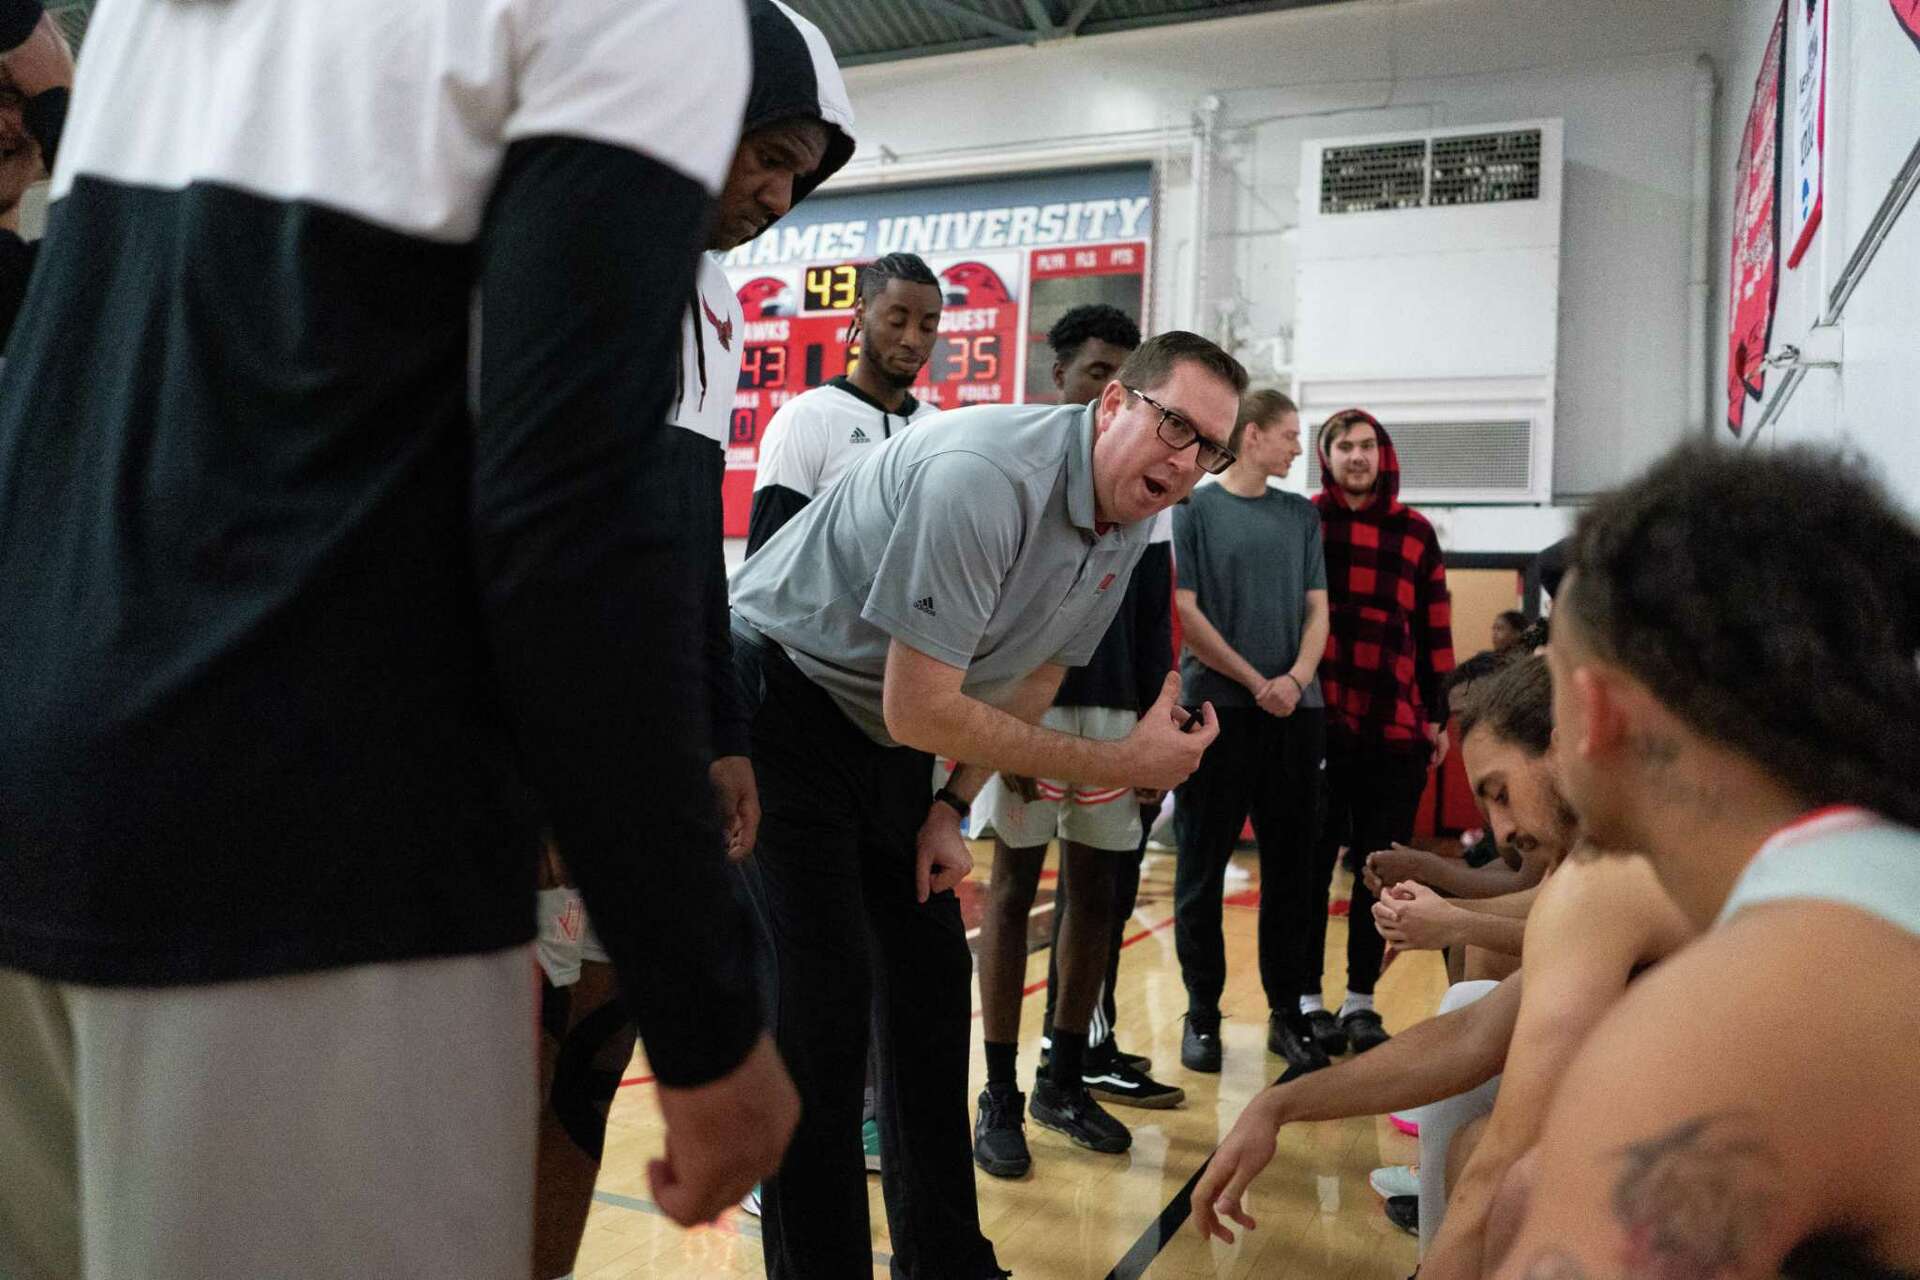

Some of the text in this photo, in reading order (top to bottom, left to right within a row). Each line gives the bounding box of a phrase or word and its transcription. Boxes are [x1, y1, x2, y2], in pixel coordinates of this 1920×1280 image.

[876, 196, 1150, 254] UNIVERSITY
[807, 265, 857, 309] 43
[743, 320, 790, 342] AWKS
[741, 346, 786, 388] 43
[946, 336, 997, 380] 35
